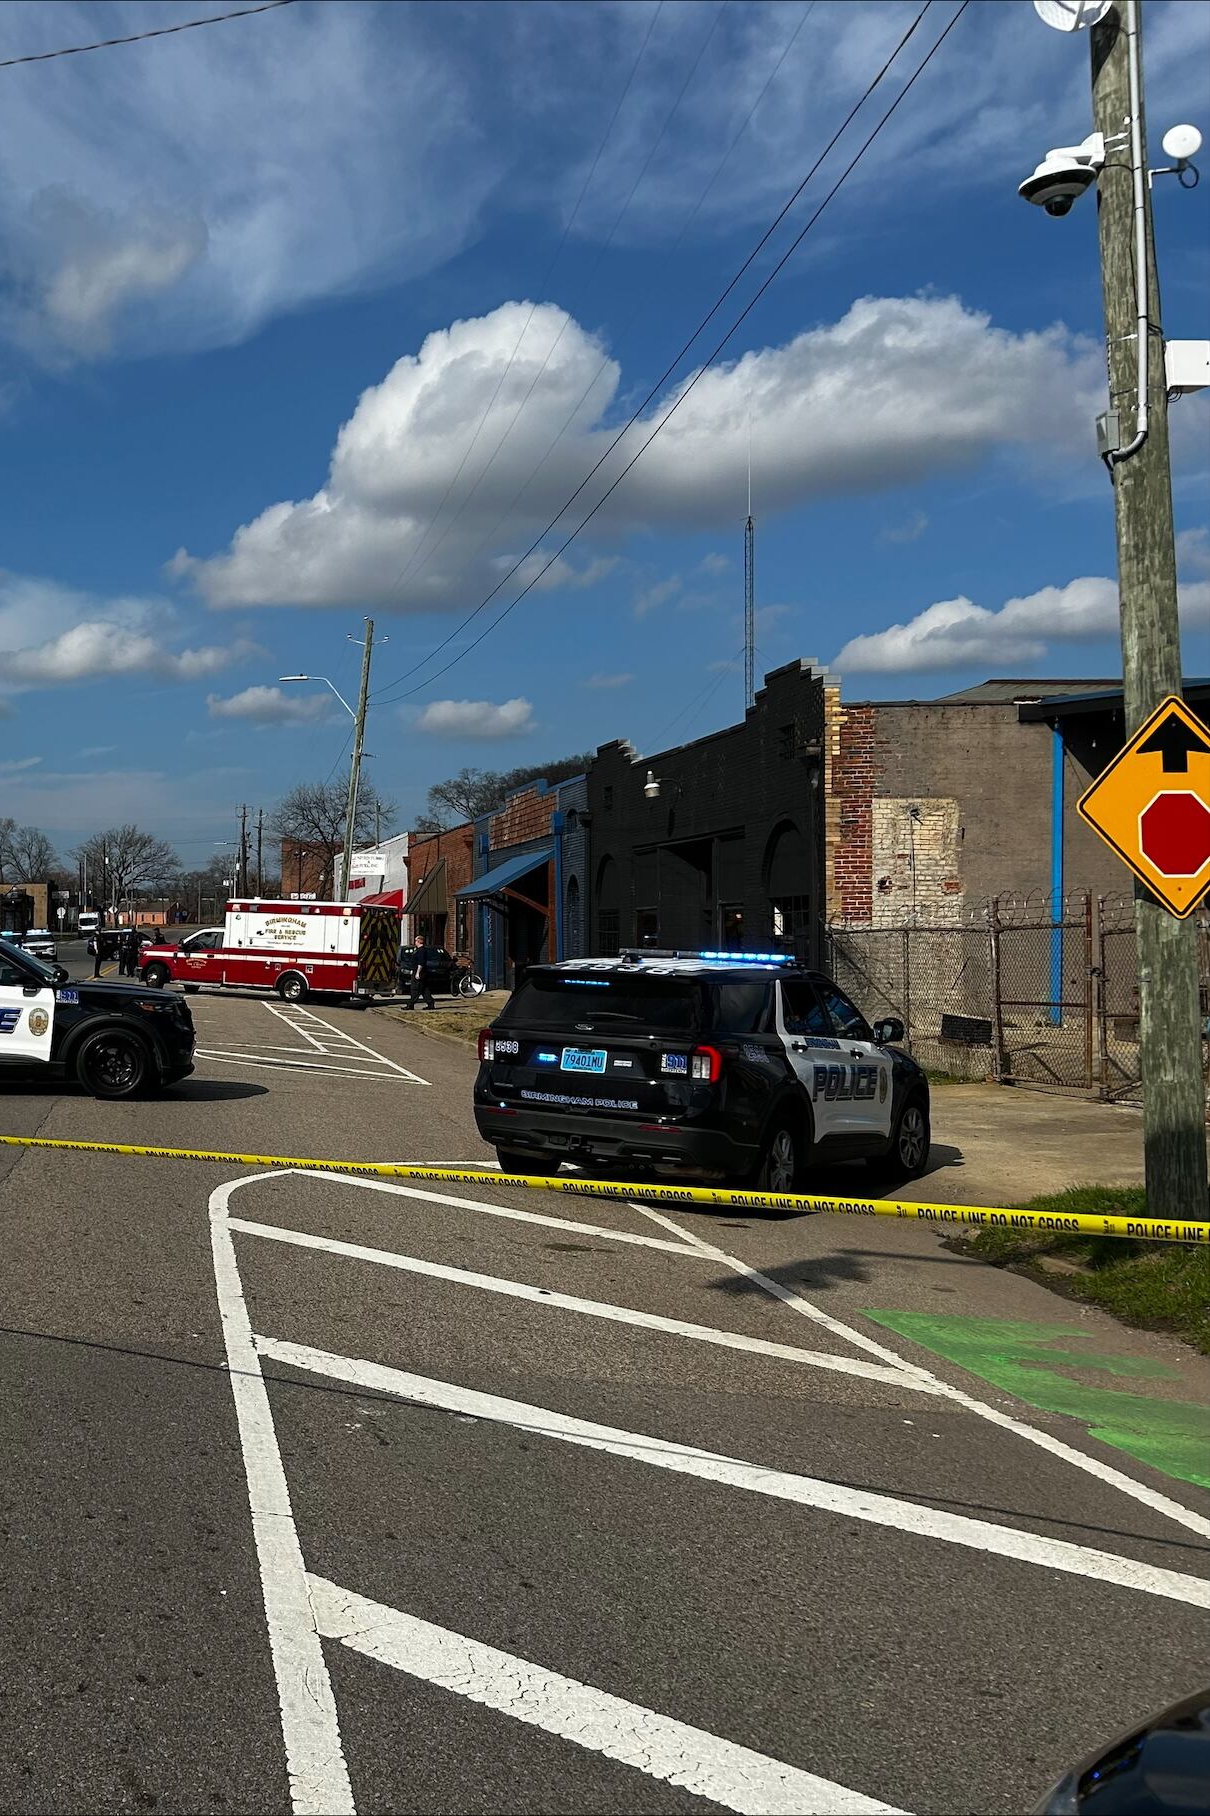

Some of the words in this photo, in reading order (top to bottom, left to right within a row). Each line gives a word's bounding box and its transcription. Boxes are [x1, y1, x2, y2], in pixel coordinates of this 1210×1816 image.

[667, 1054, 688, 1070] 911
[813, 1064, 879, 1102] POLICE
[521, 1090, 593, 1106] BIRMINGHAM
[594, 1098, 639, 1110] POLICE
[731, 1195, 766, 1207] POLICE
[769, 1197, 792, 1209] LINE
[796, 1200, 811, 1211] DO
[814, 1201, 835, 1213] NOT
[838, 1202, 876, 1216] CROSS
[917, 1208, 957, 1222] POLICE
[961, 1211, 987, 1224] LINE
[990, 1213, 1007, 1226] DO
[1011, 1215, 1034, 1228] NOT
[1038, 1216, 1079, 1232] CROSS
[1127, 1223, 1172, 1239] POLICE
[1175, 1226, 1204, 1241] LINE
